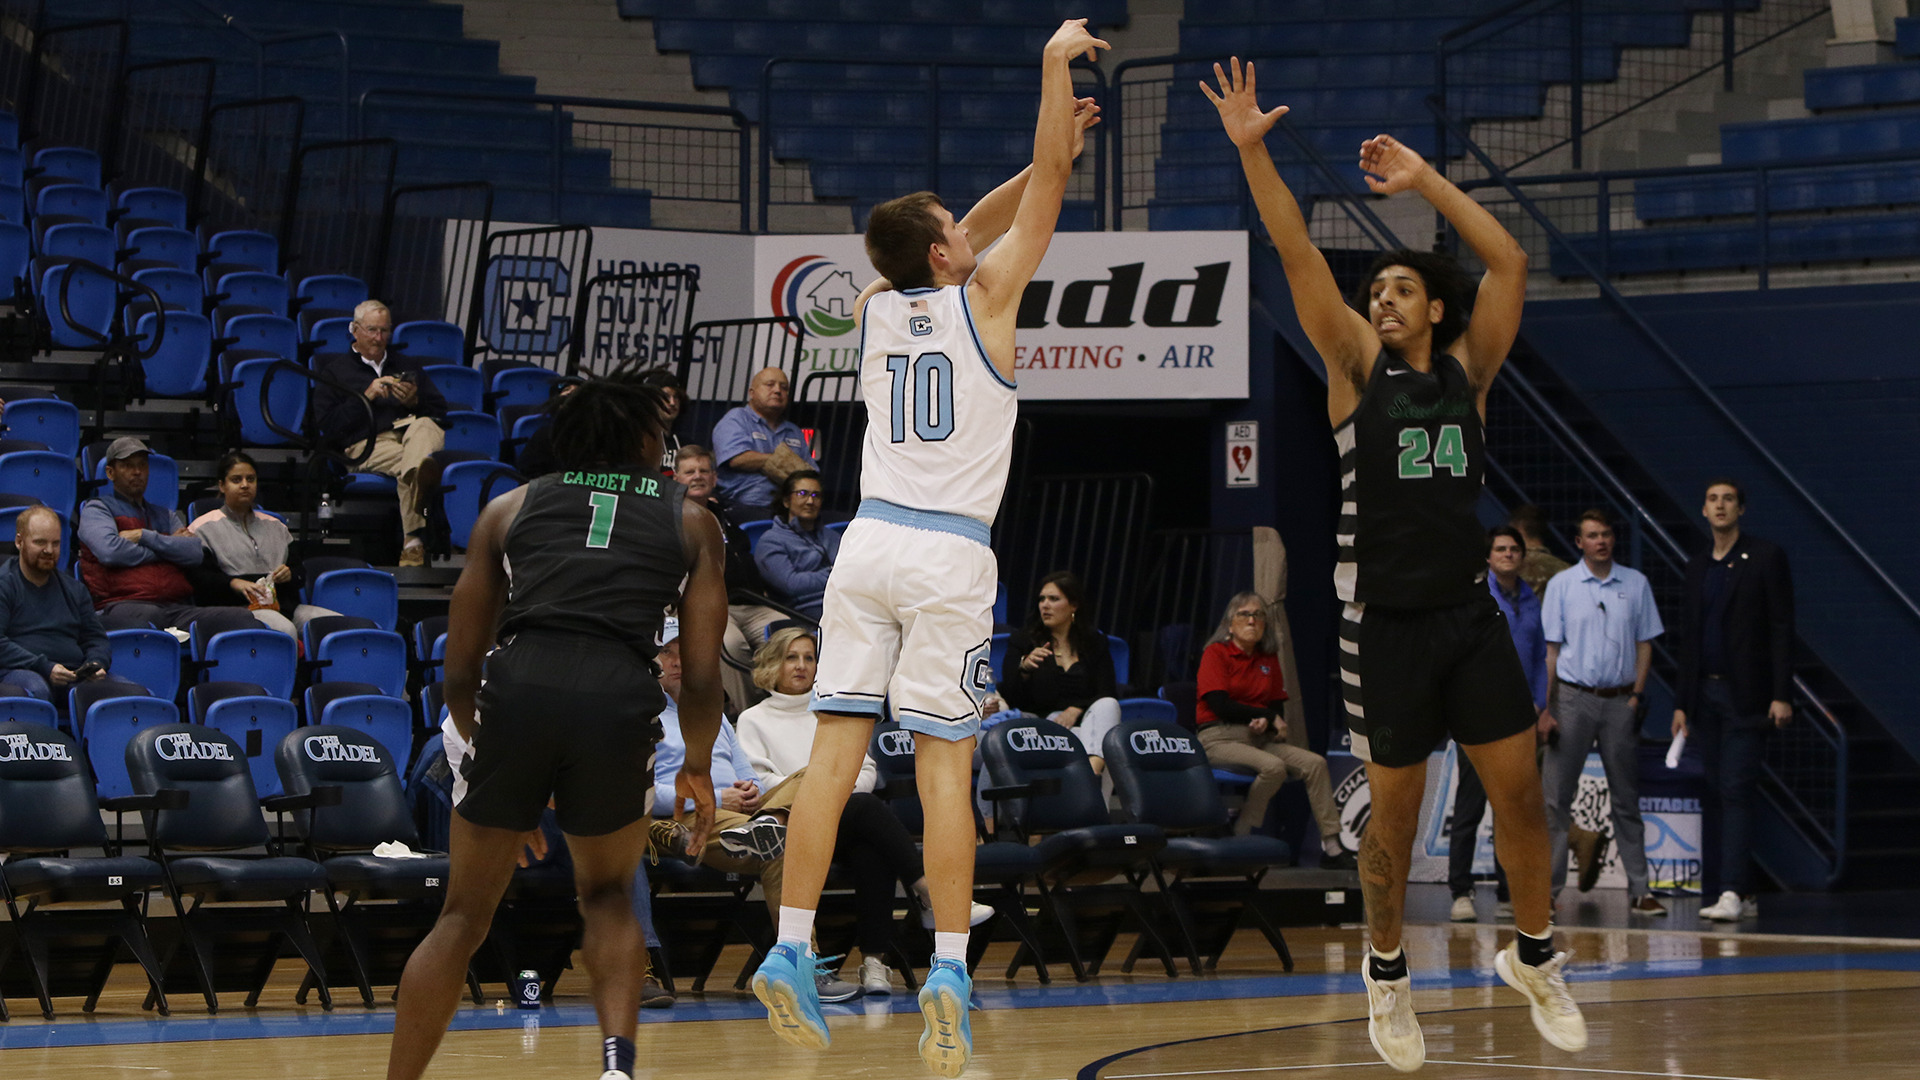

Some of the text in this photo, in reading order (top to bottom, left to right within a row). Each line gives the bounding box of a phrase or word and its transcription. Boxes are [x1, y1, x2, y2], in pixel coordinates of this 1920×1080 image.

[597, 259, 701, 292] HONOR
[597, 295, 674, 326] DUTY
[597, 332, 725, 363] RESPECT
[1157, 344, 1215, 368] AIR
[886, 351, 955, 444] 10
[1234, 425, 1251, 438] AED
[1398, 424, 1468, 479] 24
[563, 471, 661, 498] CARDET JR.
[585, 490, 619, 549] 1
[154, 734, 235, 761] CITADEL
[304, 736, 381, 763] CITADEL
[1006, 728, 1075, 752] CITADEL
[1130, 731, 1196, 755] CITADEL
[1638, 796, 1702, 813] CITADEL
[1672, 858, 1702, 890] UP
